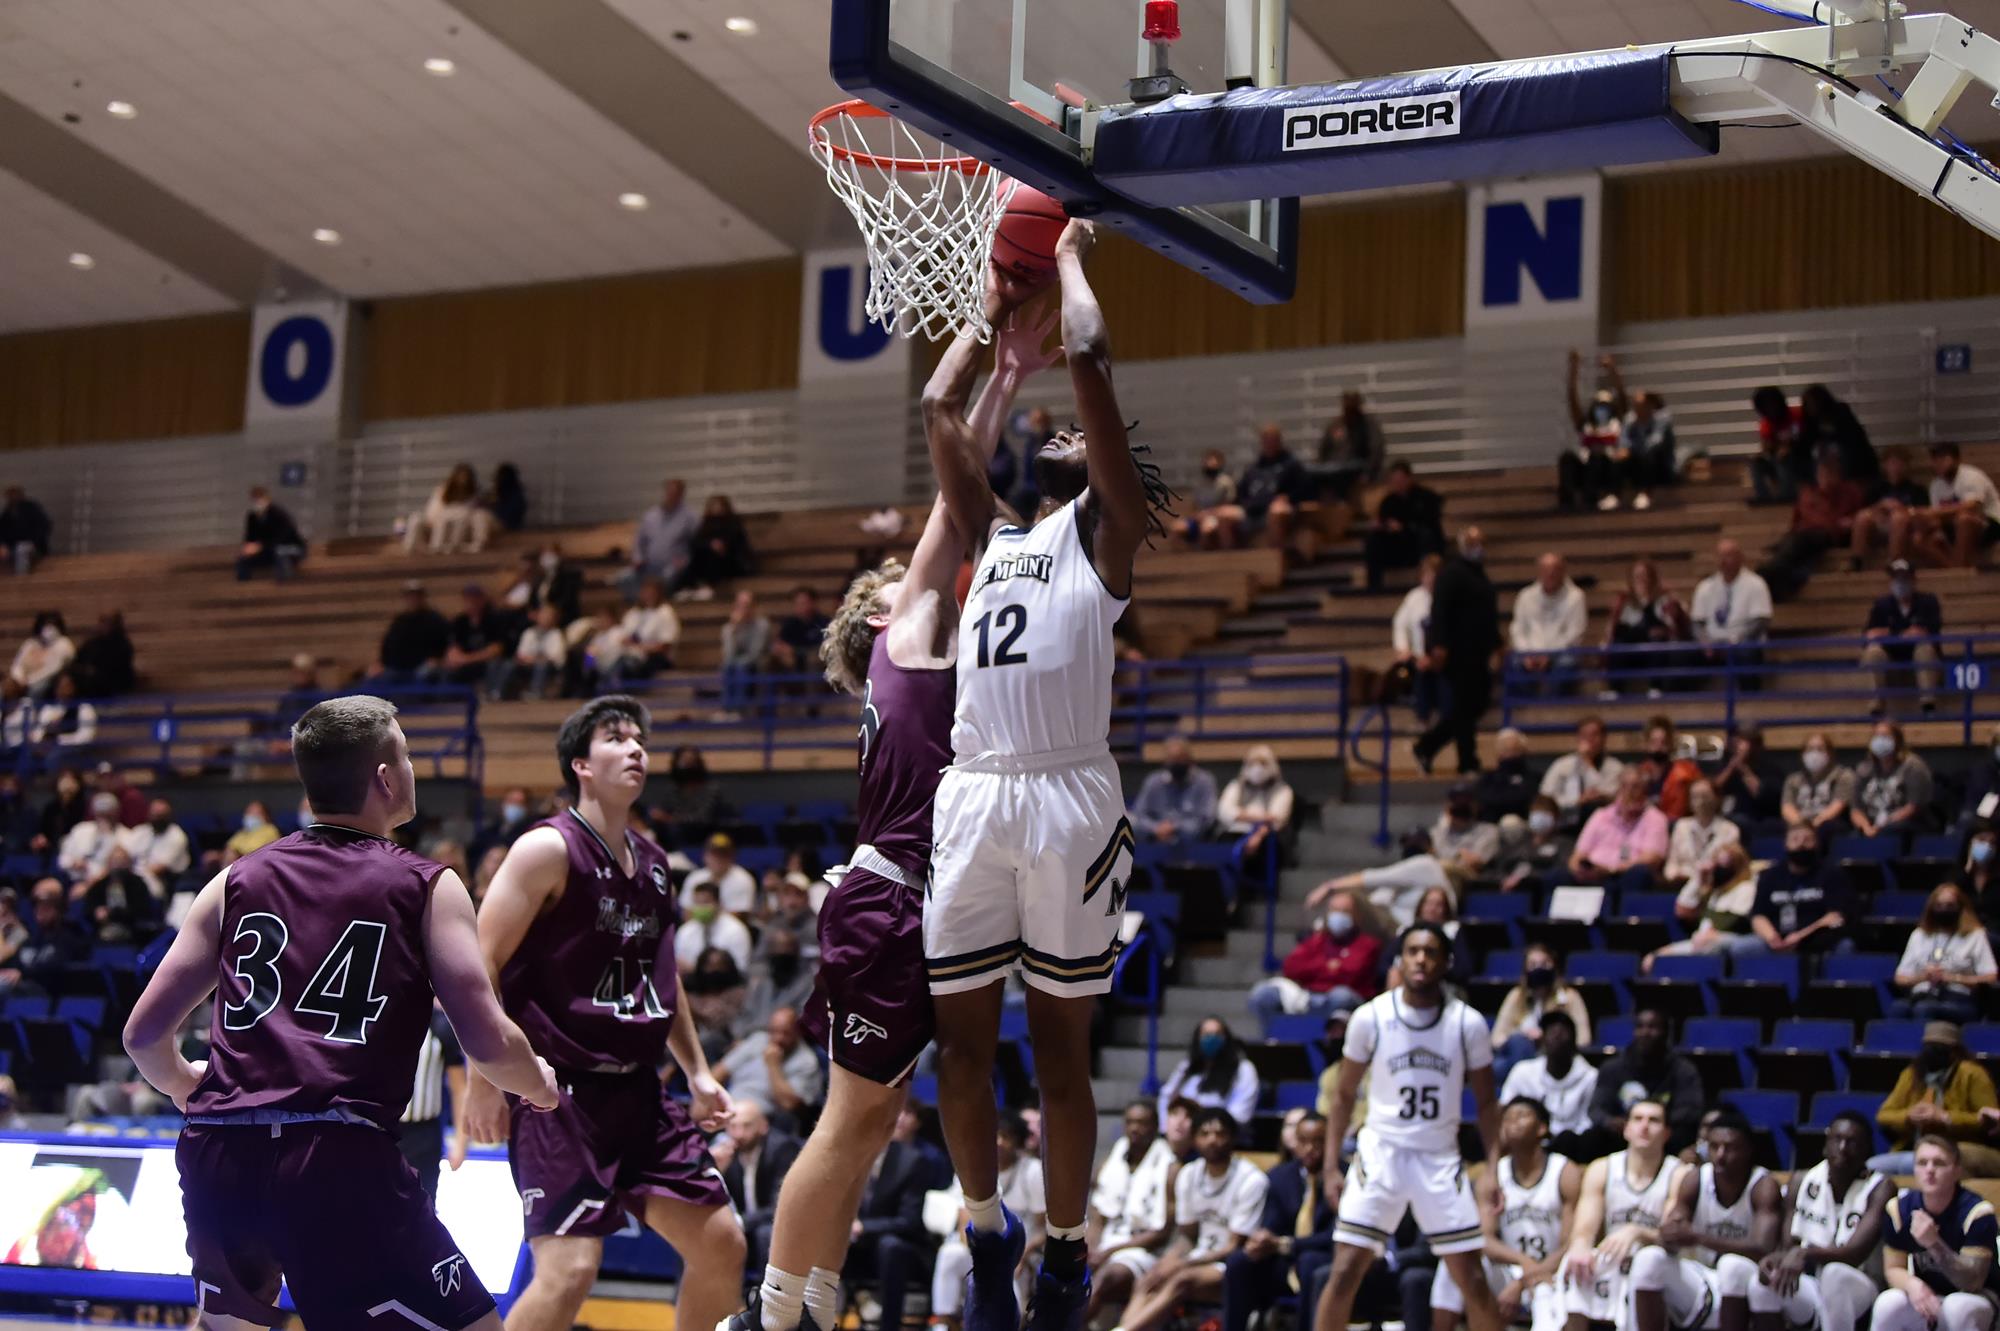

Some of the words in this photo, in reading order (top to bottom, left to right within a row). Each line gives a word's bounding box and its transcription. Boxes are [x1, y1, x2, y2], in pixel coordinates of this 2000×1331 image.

[1483, 196, 1584, 307] N
[820, 265, 894, 360] U
[261, 315, 334, 406] O
[973, 604, 1027, 669] 12
[1954, 664, 1980, 690] 10
[224, 912, 389, 1045] 34
[1399, 1086, 1440, 1120] 35
